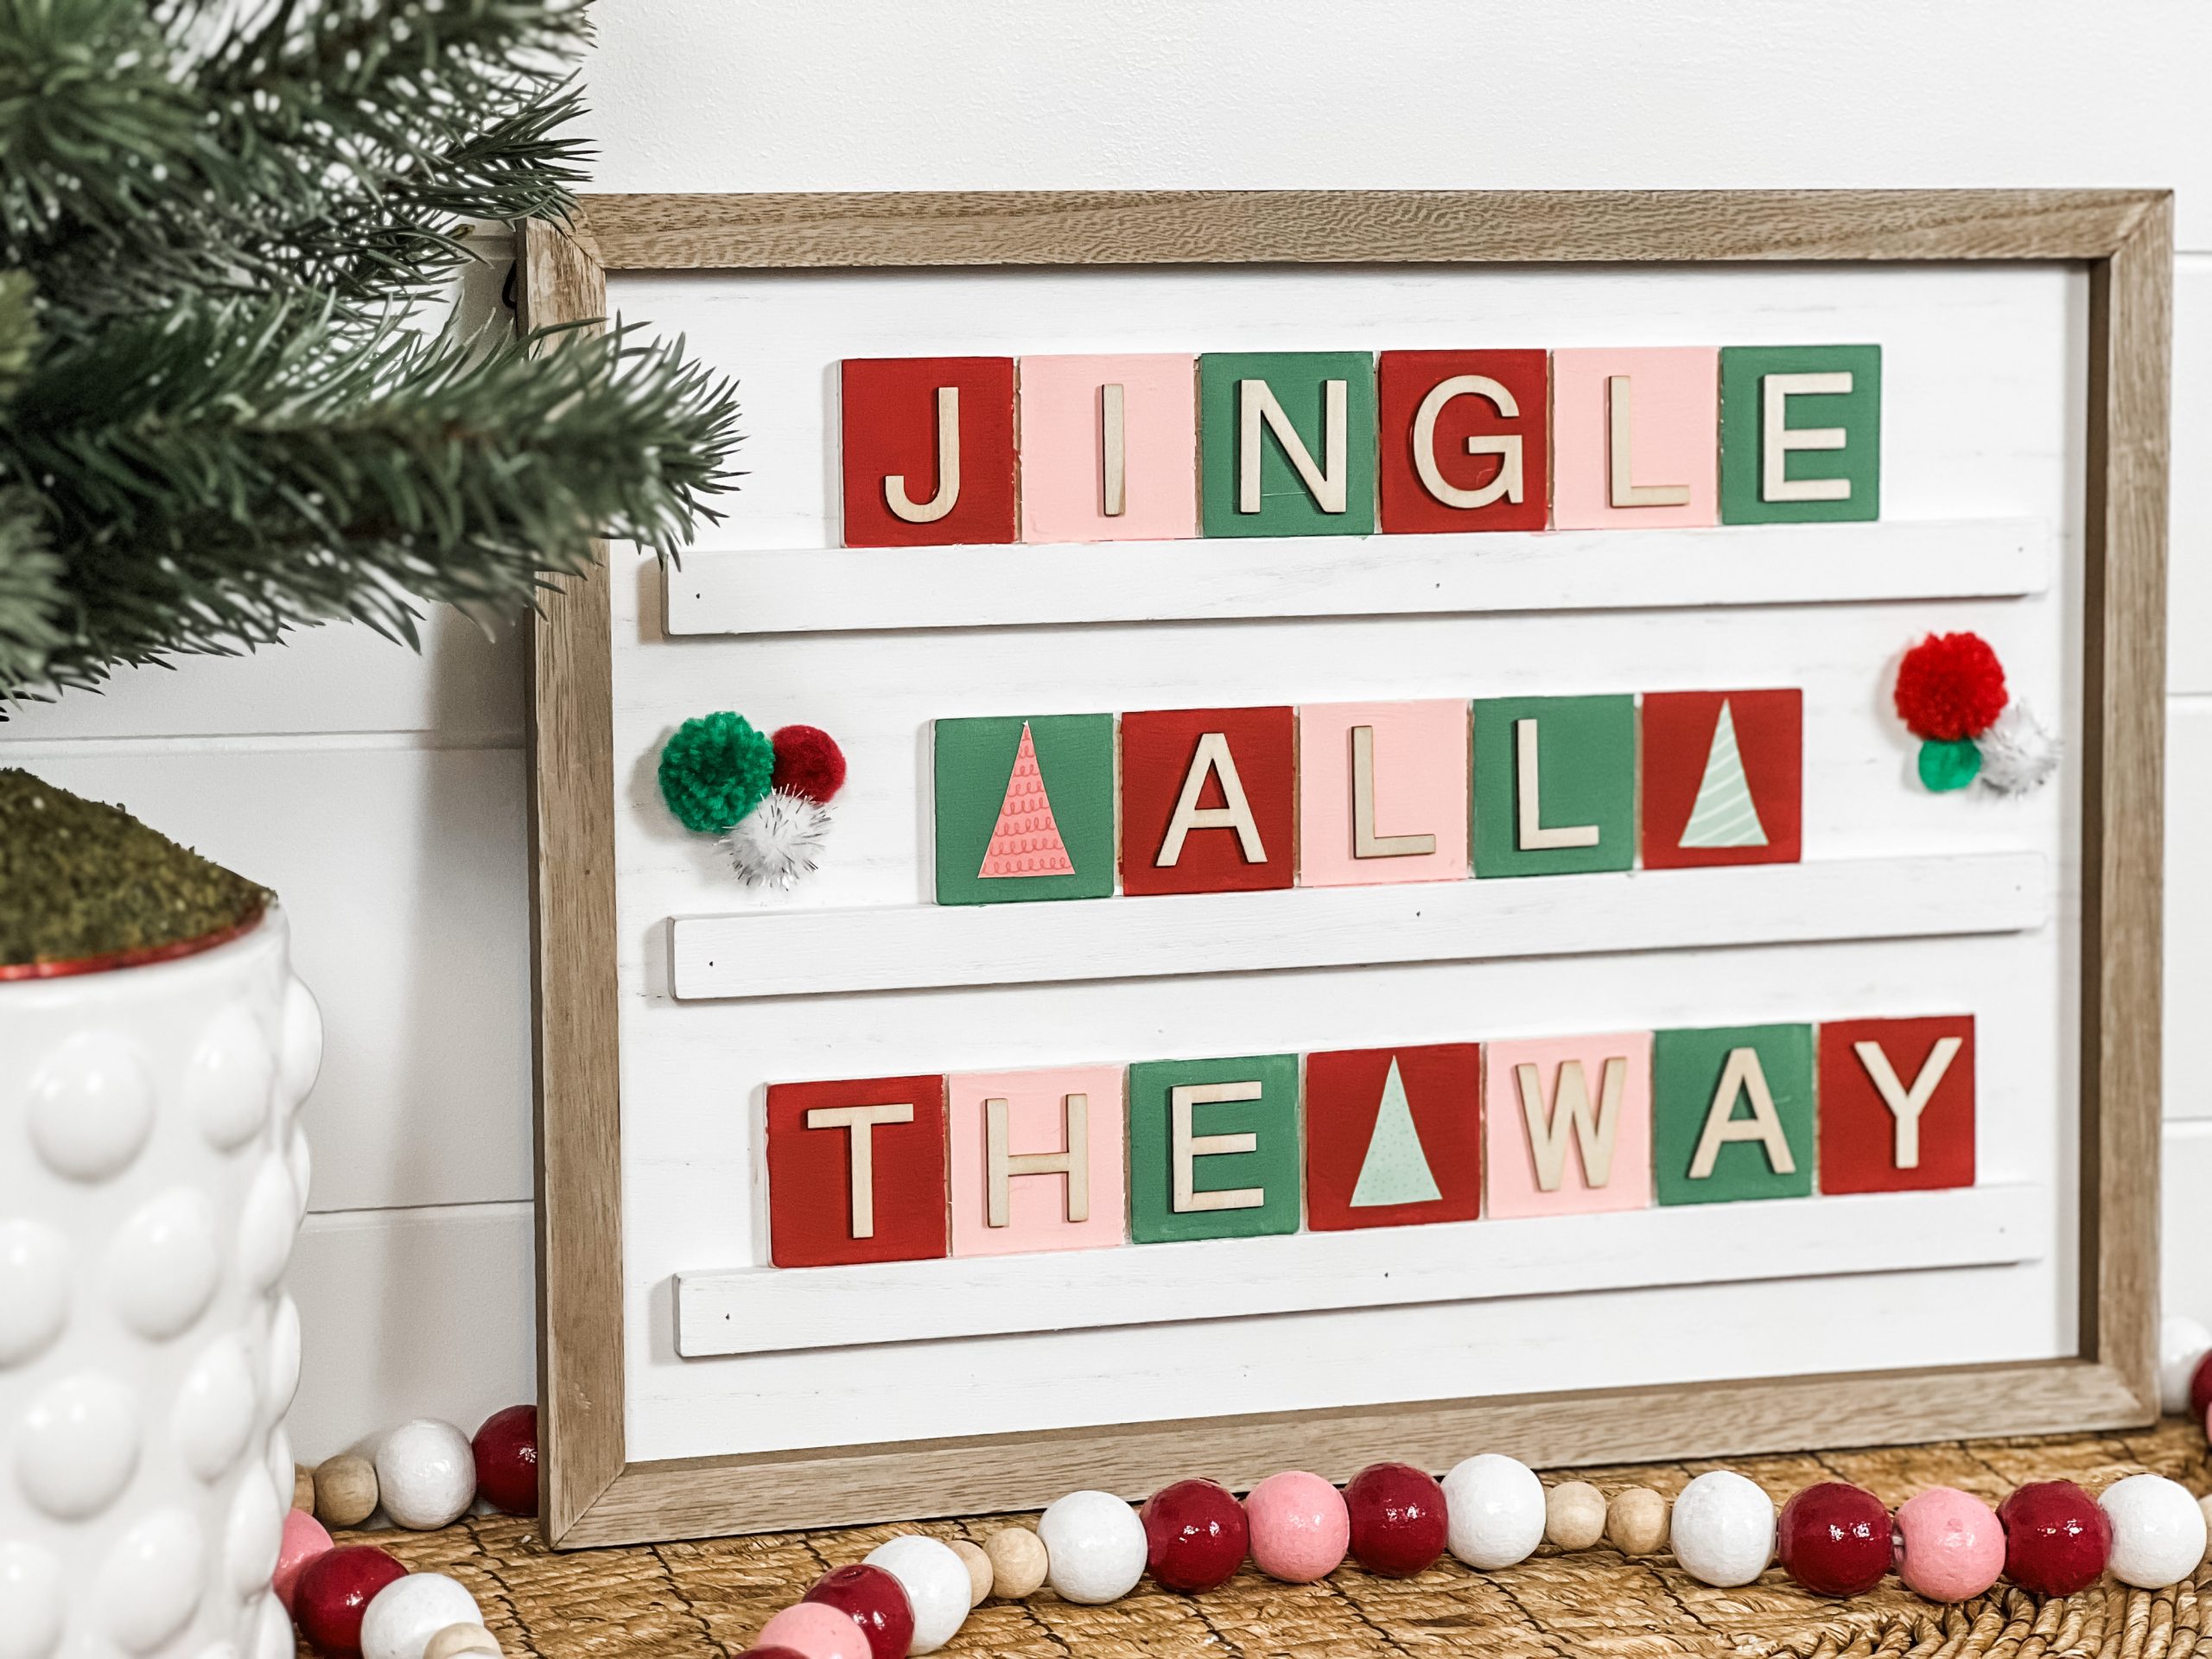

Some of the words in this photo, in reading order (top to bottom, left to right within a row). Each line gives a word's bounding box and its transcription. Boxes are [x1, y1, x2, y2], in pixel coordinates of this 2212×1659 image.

[883, 372, 1854, 524] JINGLE
[1155, 717, 1600, 868] ALL
[805, 1080, 1265, 1241] THE
[1516, 1037, 1962, 1192] WAY
